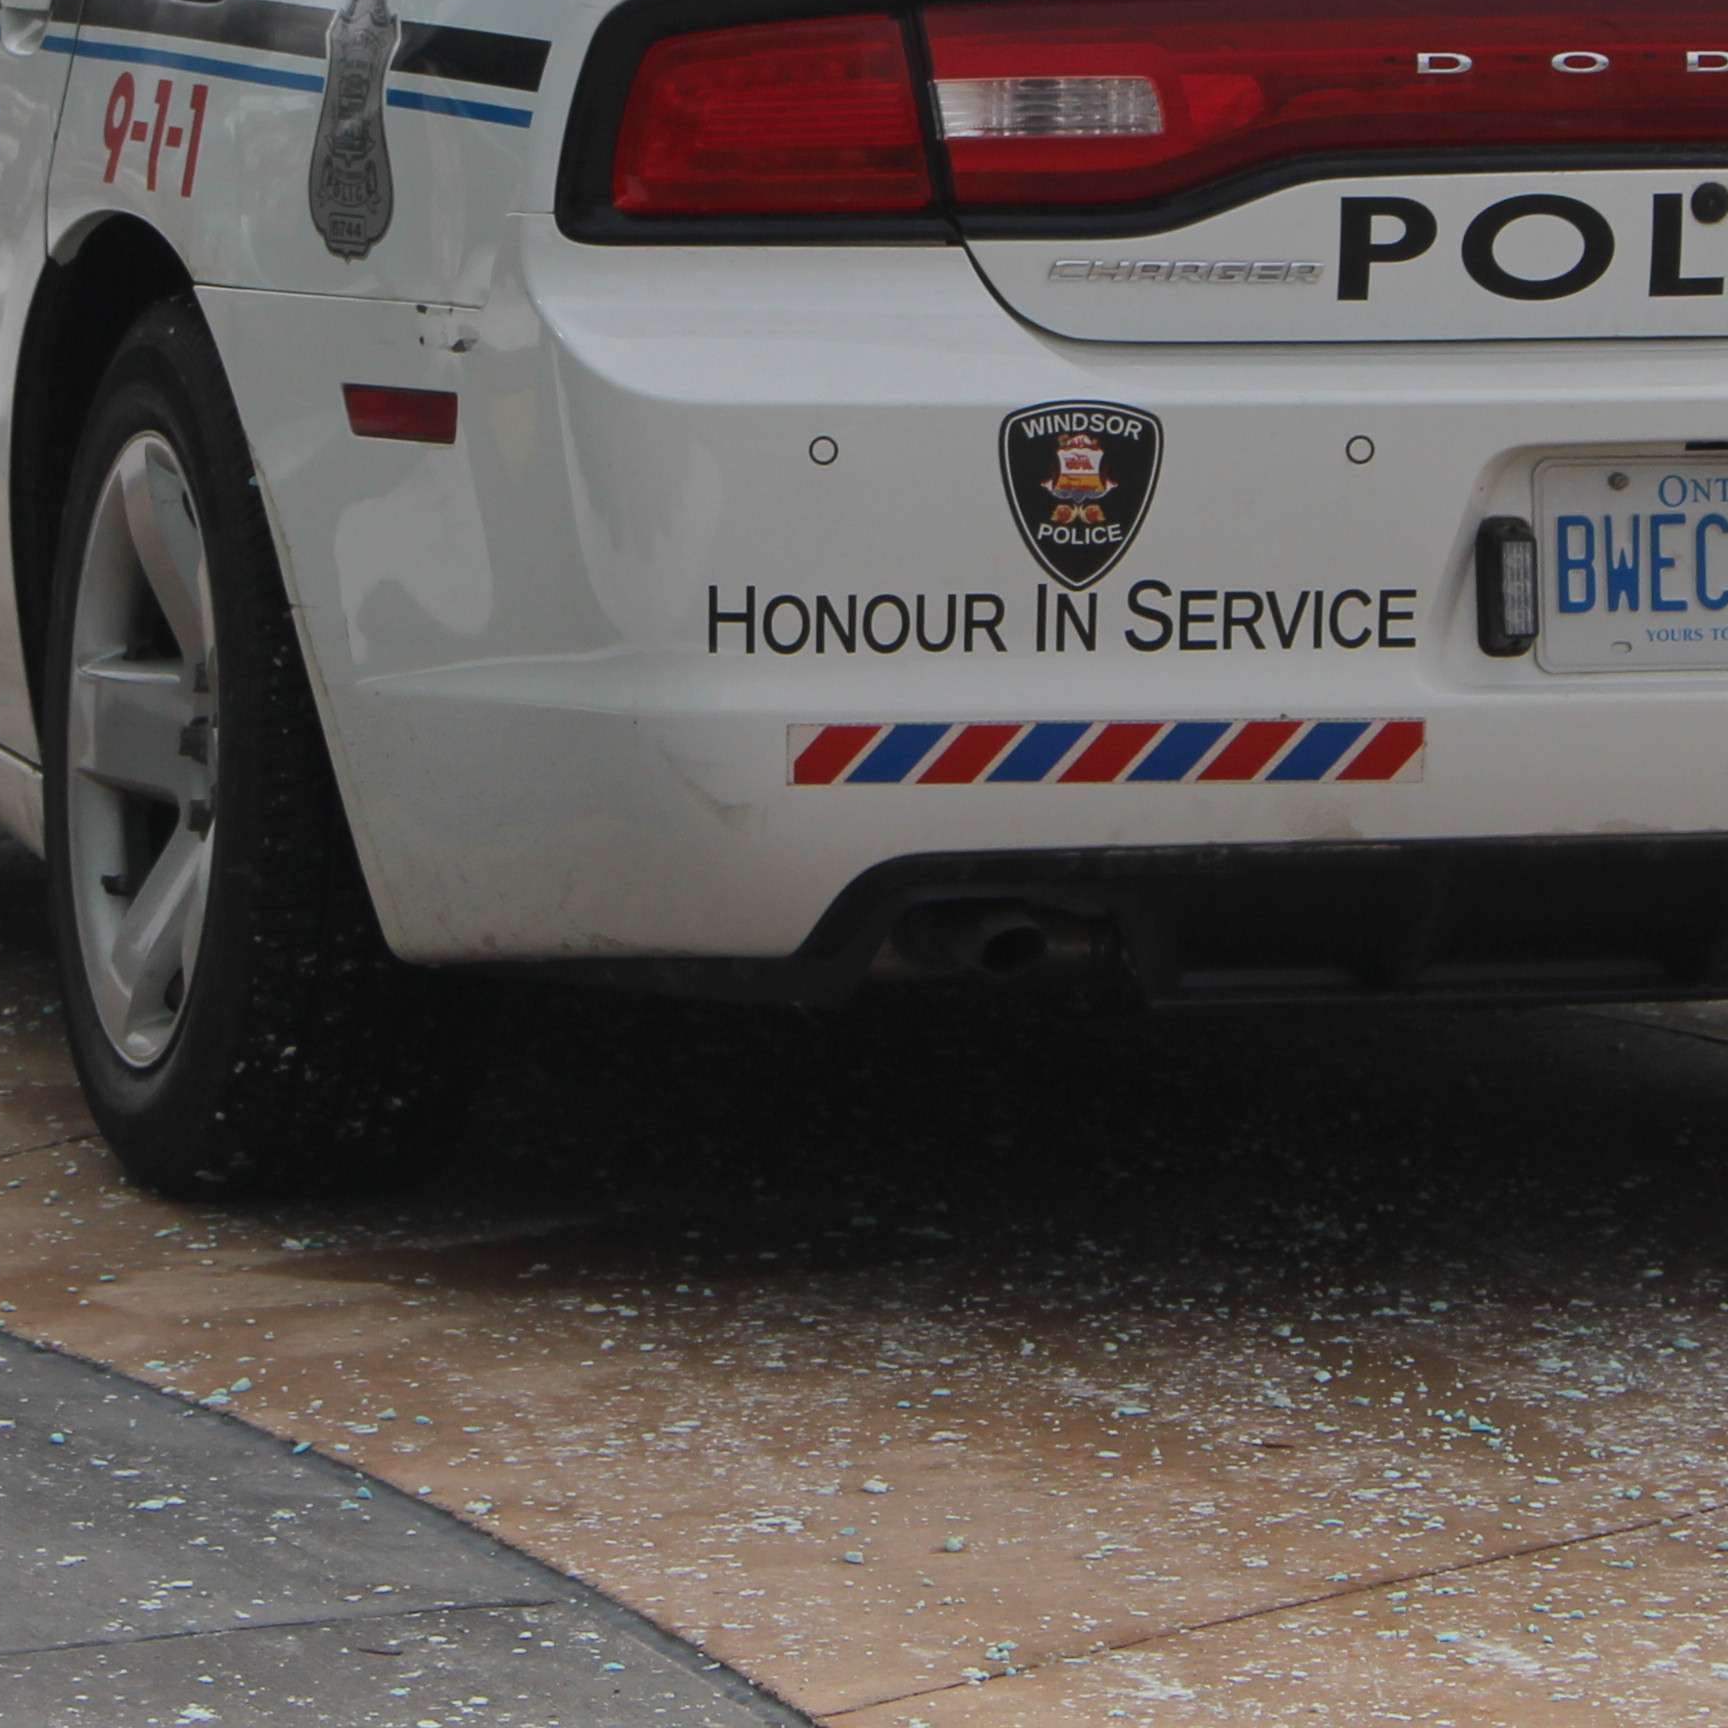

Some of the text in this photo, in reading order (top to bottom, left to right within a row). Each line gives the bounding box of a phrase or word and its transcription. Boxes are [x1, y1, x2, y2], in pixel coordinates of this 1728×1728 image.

[103, 71, 209, 198] 9-1-1
[1048, 258, 1325, 284] CHARGER
[1022, 412, 1143, 440] WINDSOR
[1037, 523, 1123, 545] POLICE
[707, 579, 1418, 655] HONOUR IN SERVICE
[1646, 628, 1704, 643] YOURS
